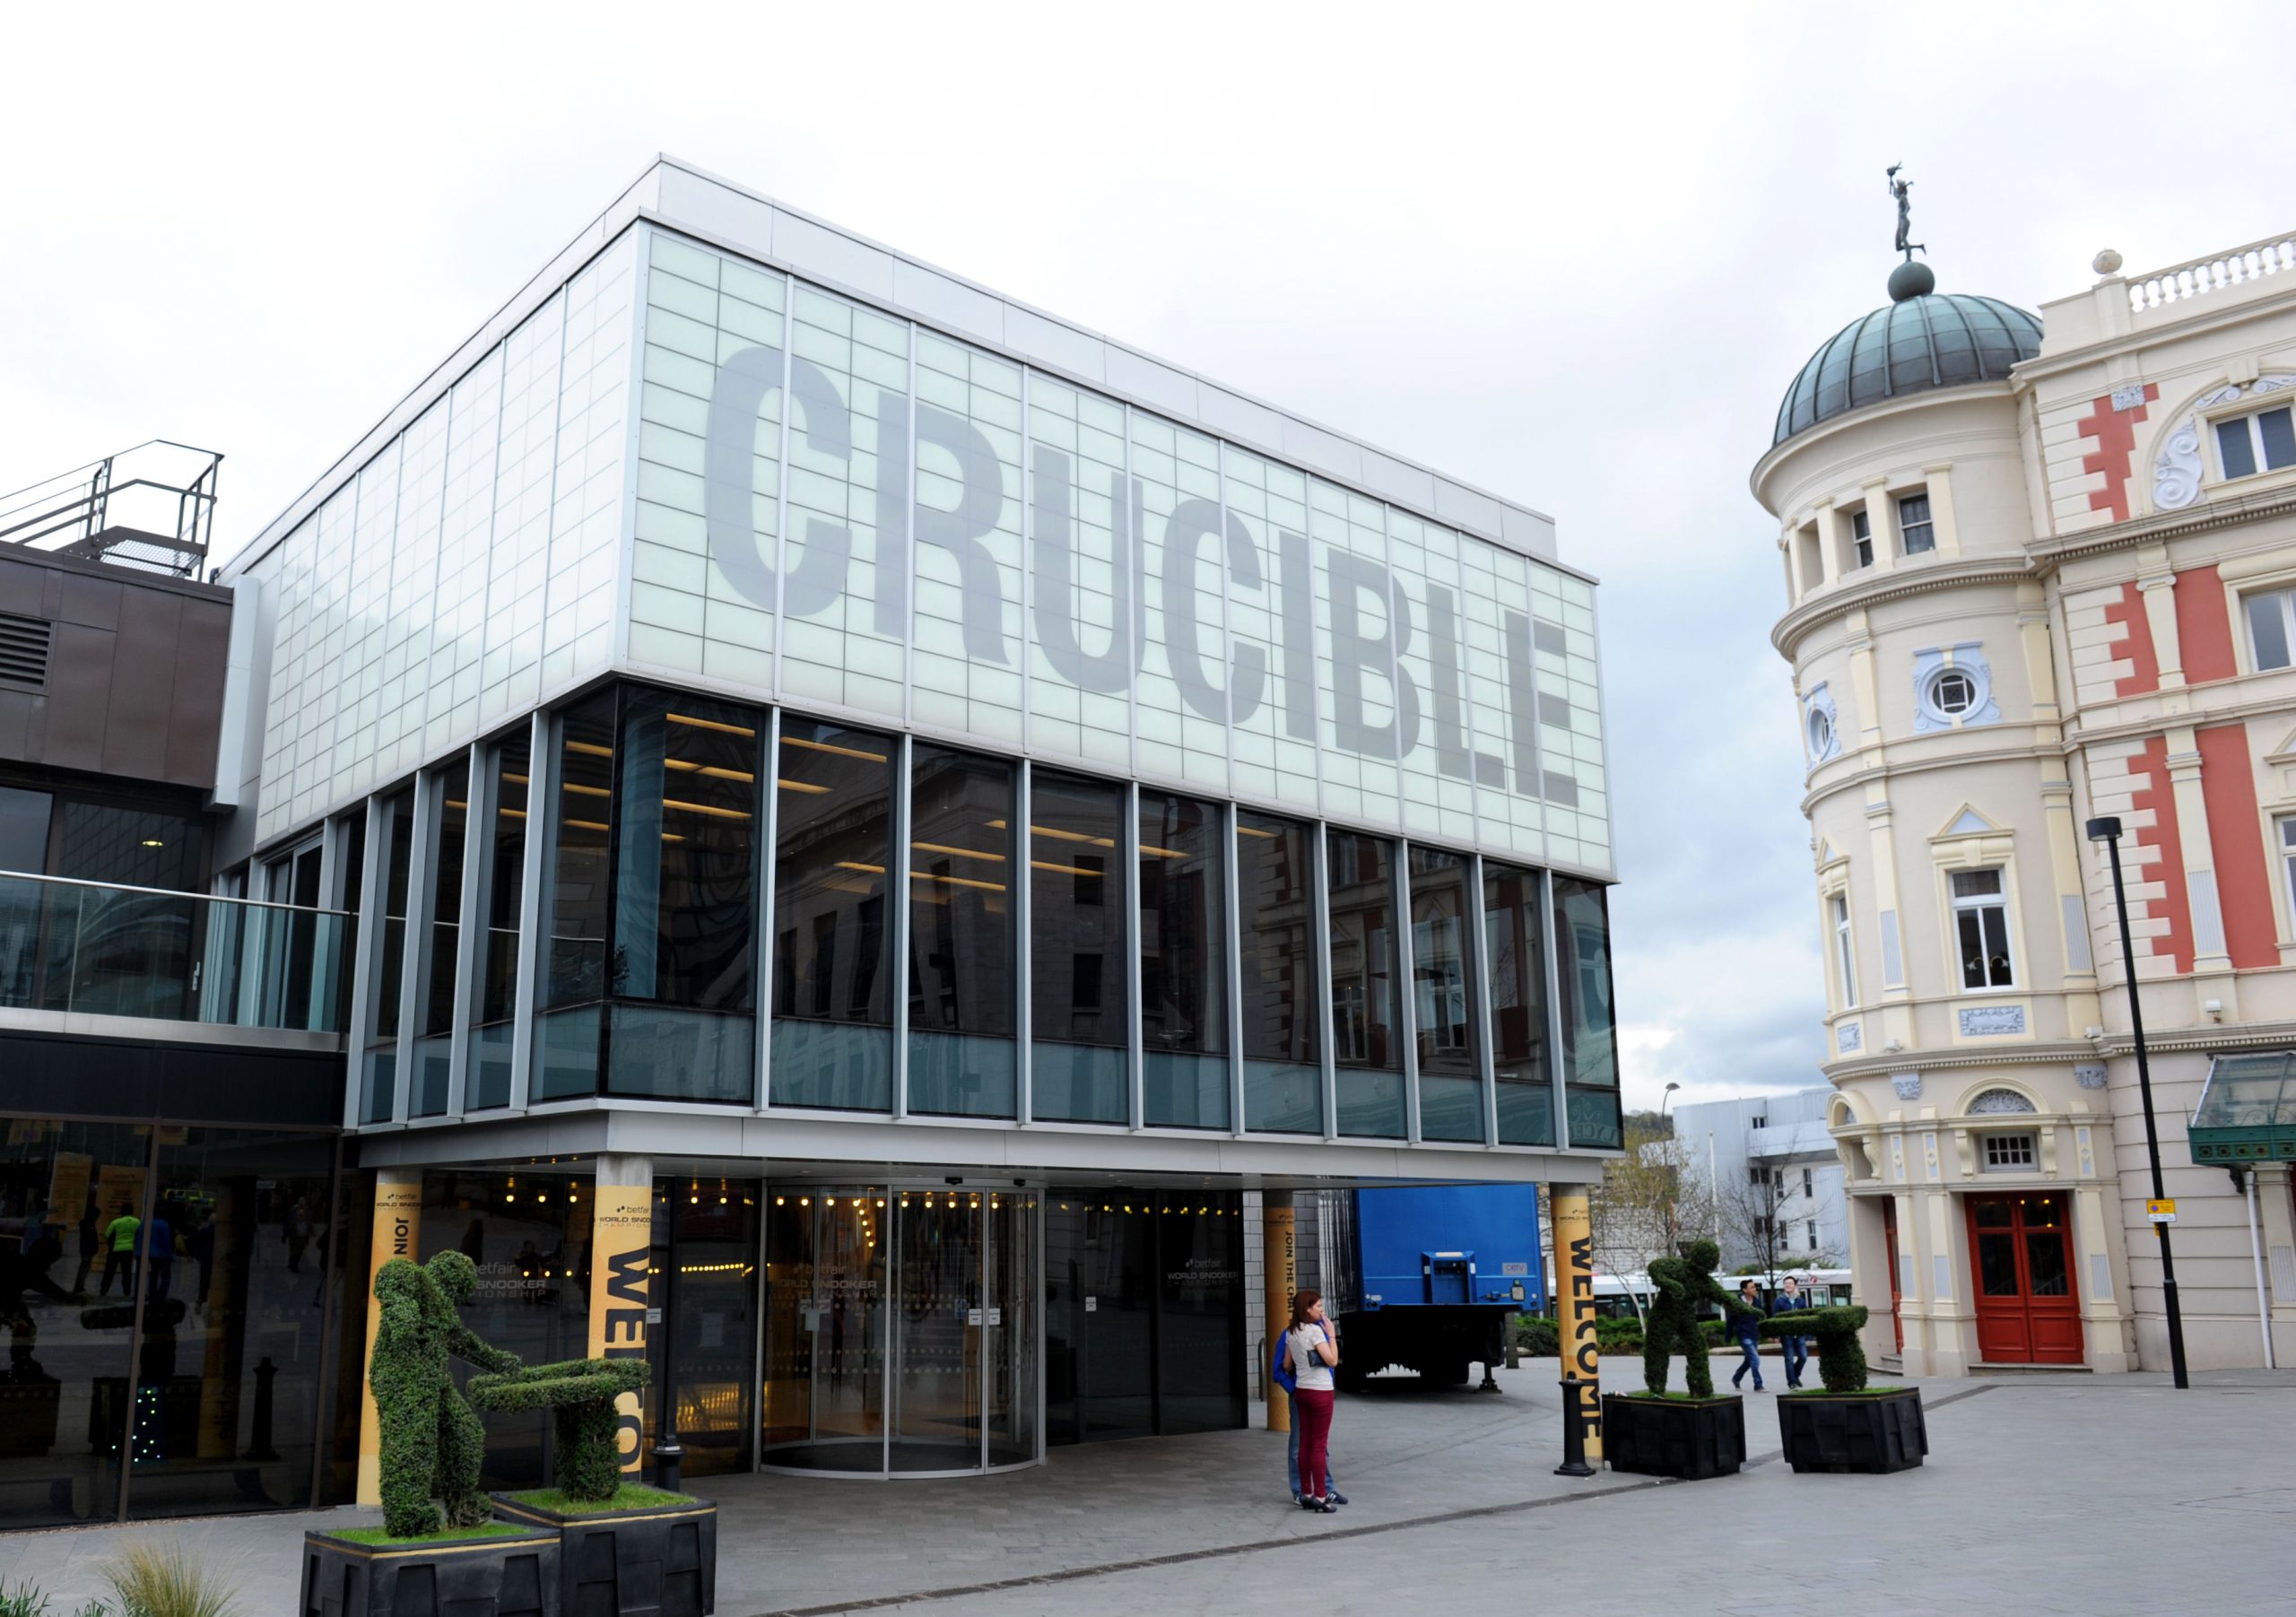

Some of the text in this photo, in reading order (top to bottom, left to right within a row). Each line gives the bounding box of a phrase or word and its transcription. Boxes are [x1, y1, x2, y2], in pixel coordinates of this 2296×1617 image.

[706, 345, 1579, 807] CRUCIBLE
[394, 1216, 409, 1256] JOIN
[1285, 1230, 1293, 1257] JOIN
[478, 1261, 517, 1274] etfair
[805, 1262, 848, 1274] btfair
[1286, 1261, 1294, 1283] THE
[475, 1280, 545, 1289] SNOOKER
[778, 1279, 809, 1289] ORLD
[1570, 1235, 1601, 1439] WELCOME
